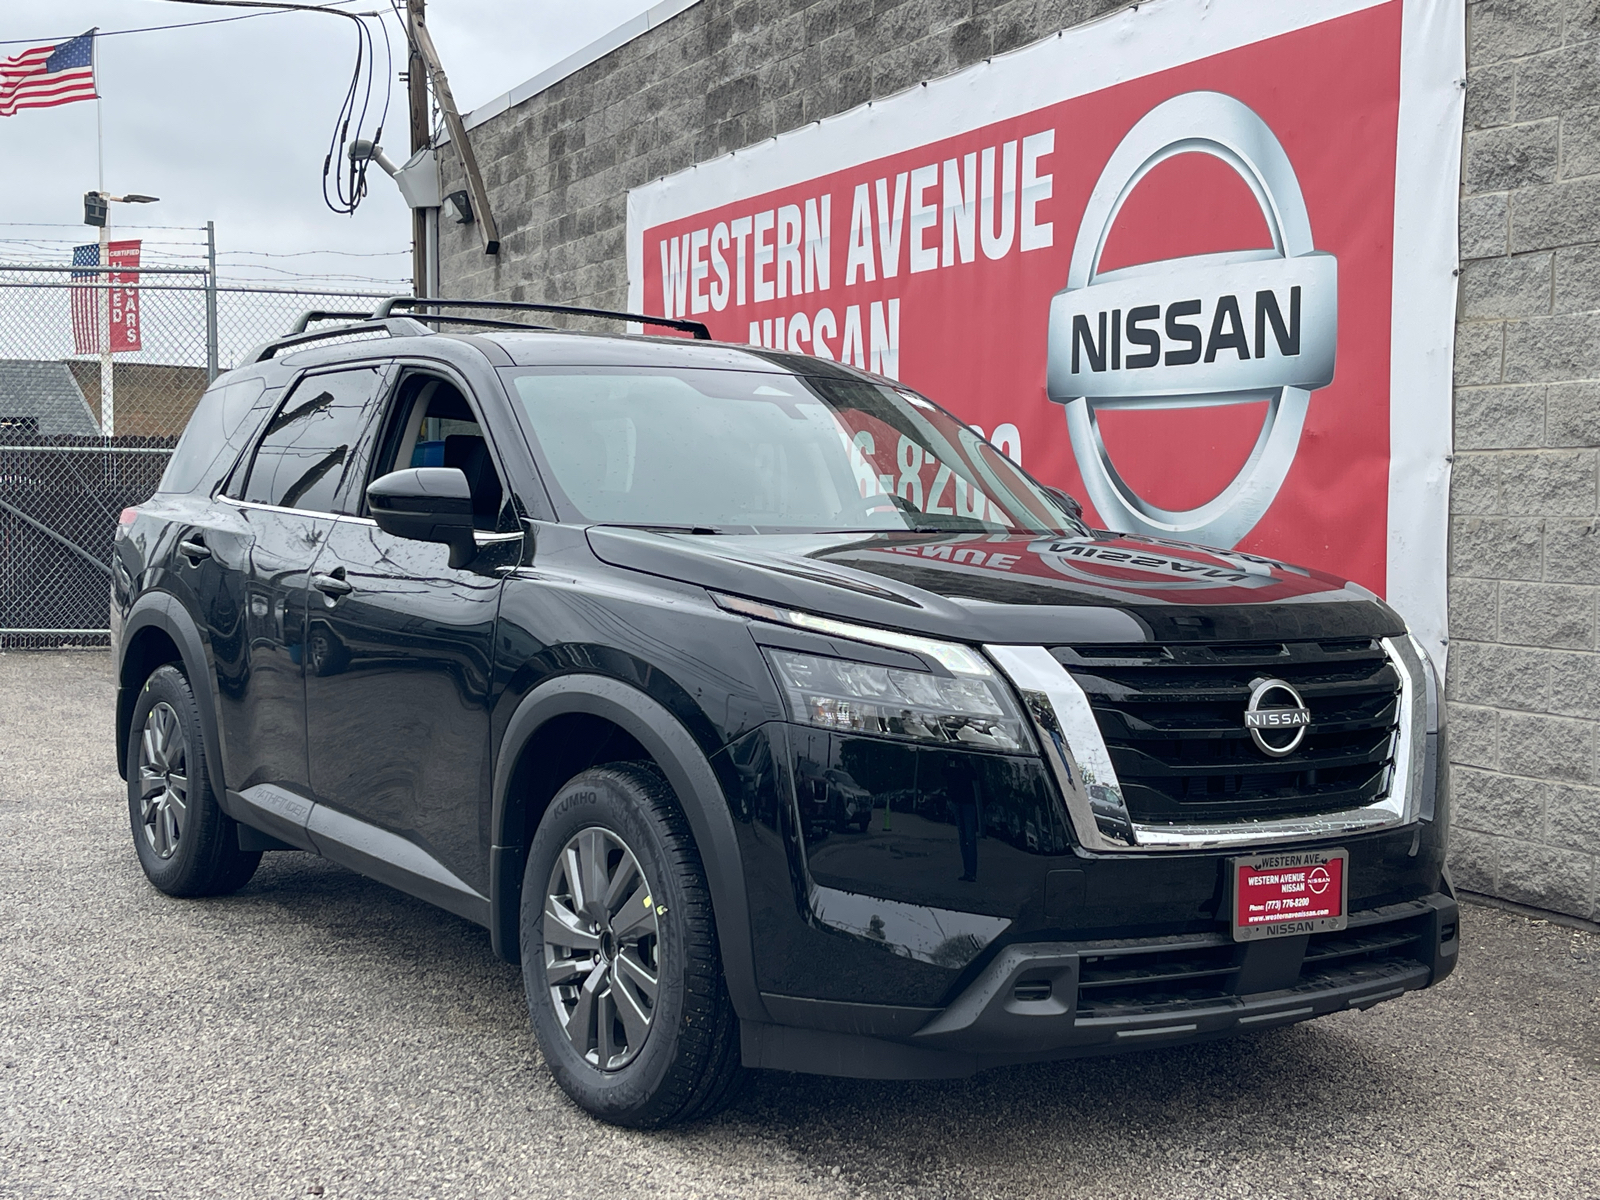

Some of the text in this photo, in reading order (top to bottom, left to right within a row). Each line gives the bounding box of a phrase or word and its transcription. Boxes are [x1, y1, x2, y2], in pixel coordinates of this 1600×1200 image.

[660, 129, 1055, 319] WESTERN AVENUE
[109, 249, 140, 257] CERTIFIED
[125, 281, 137, 343] CARS
[1071, 285, 1301, 374] NISSAN
[749, 298, 900, 382] SAN
[1247, 711, 1310, 726] NISSAN
[553, 791, 597, 820] KUMHO
[1261, 855, 1302, 868] WESTERN
[1248, 873, 1305, 886] WESTERN AVENUE
[1281, 883, 1305, 893] NISSAN
[1265, 900, 1281, 912] (773)
[1282, 897, 1310, 908] 776-8200
[1248, 909, 1329, 922] www.westernavenissan.com
[1266, 921, 1314, 936] NISSAN
